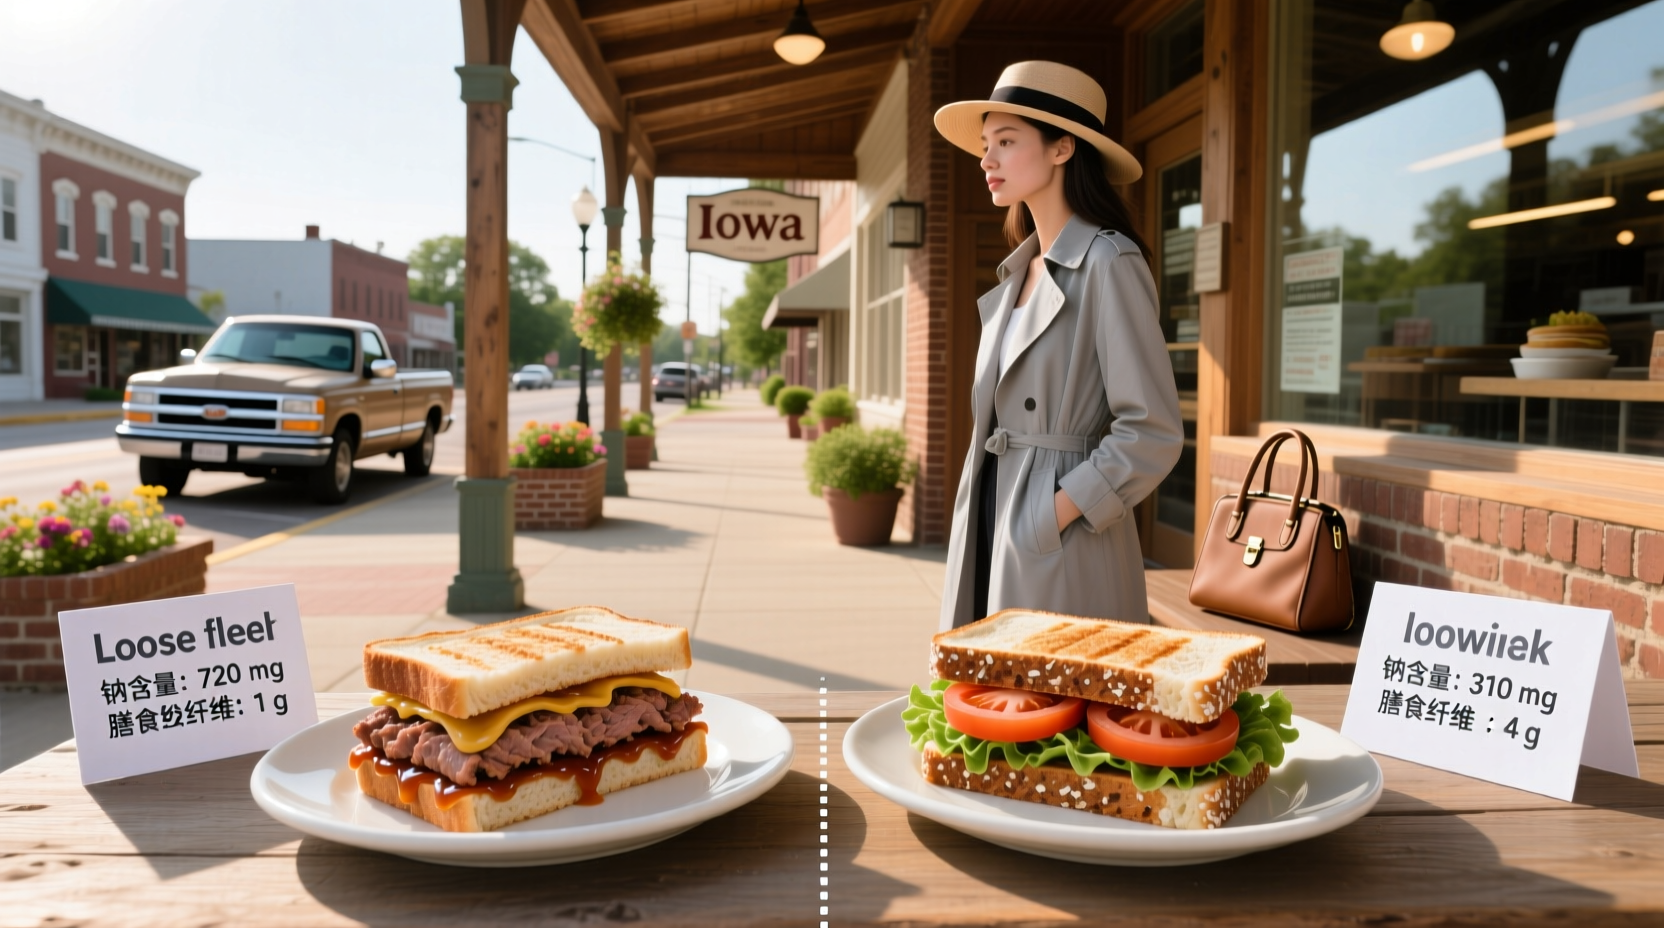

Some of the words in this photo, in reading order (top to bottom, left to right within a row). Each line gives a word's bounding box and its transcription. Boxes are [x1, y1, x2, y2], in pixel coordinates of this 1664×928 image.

[698, 204, 805, 241] Iowa
[93, 630, 196, 664] Loose
[100, 671, 187, 705] 钠含量：
[197, 663, 241, 689] 720
[249, 661, 284, 683] mg
[1382, 654, 1460, 691] 钠含量：
[1469, 672, 1513, 700] 310
[1518, 686, 1558, 715] mg
[253, 692, 265, 712] 1
[273, 693, 288, 716] g
[1503, 717, 1519, 739] 4
[1523, 726, 1541, 750] g
